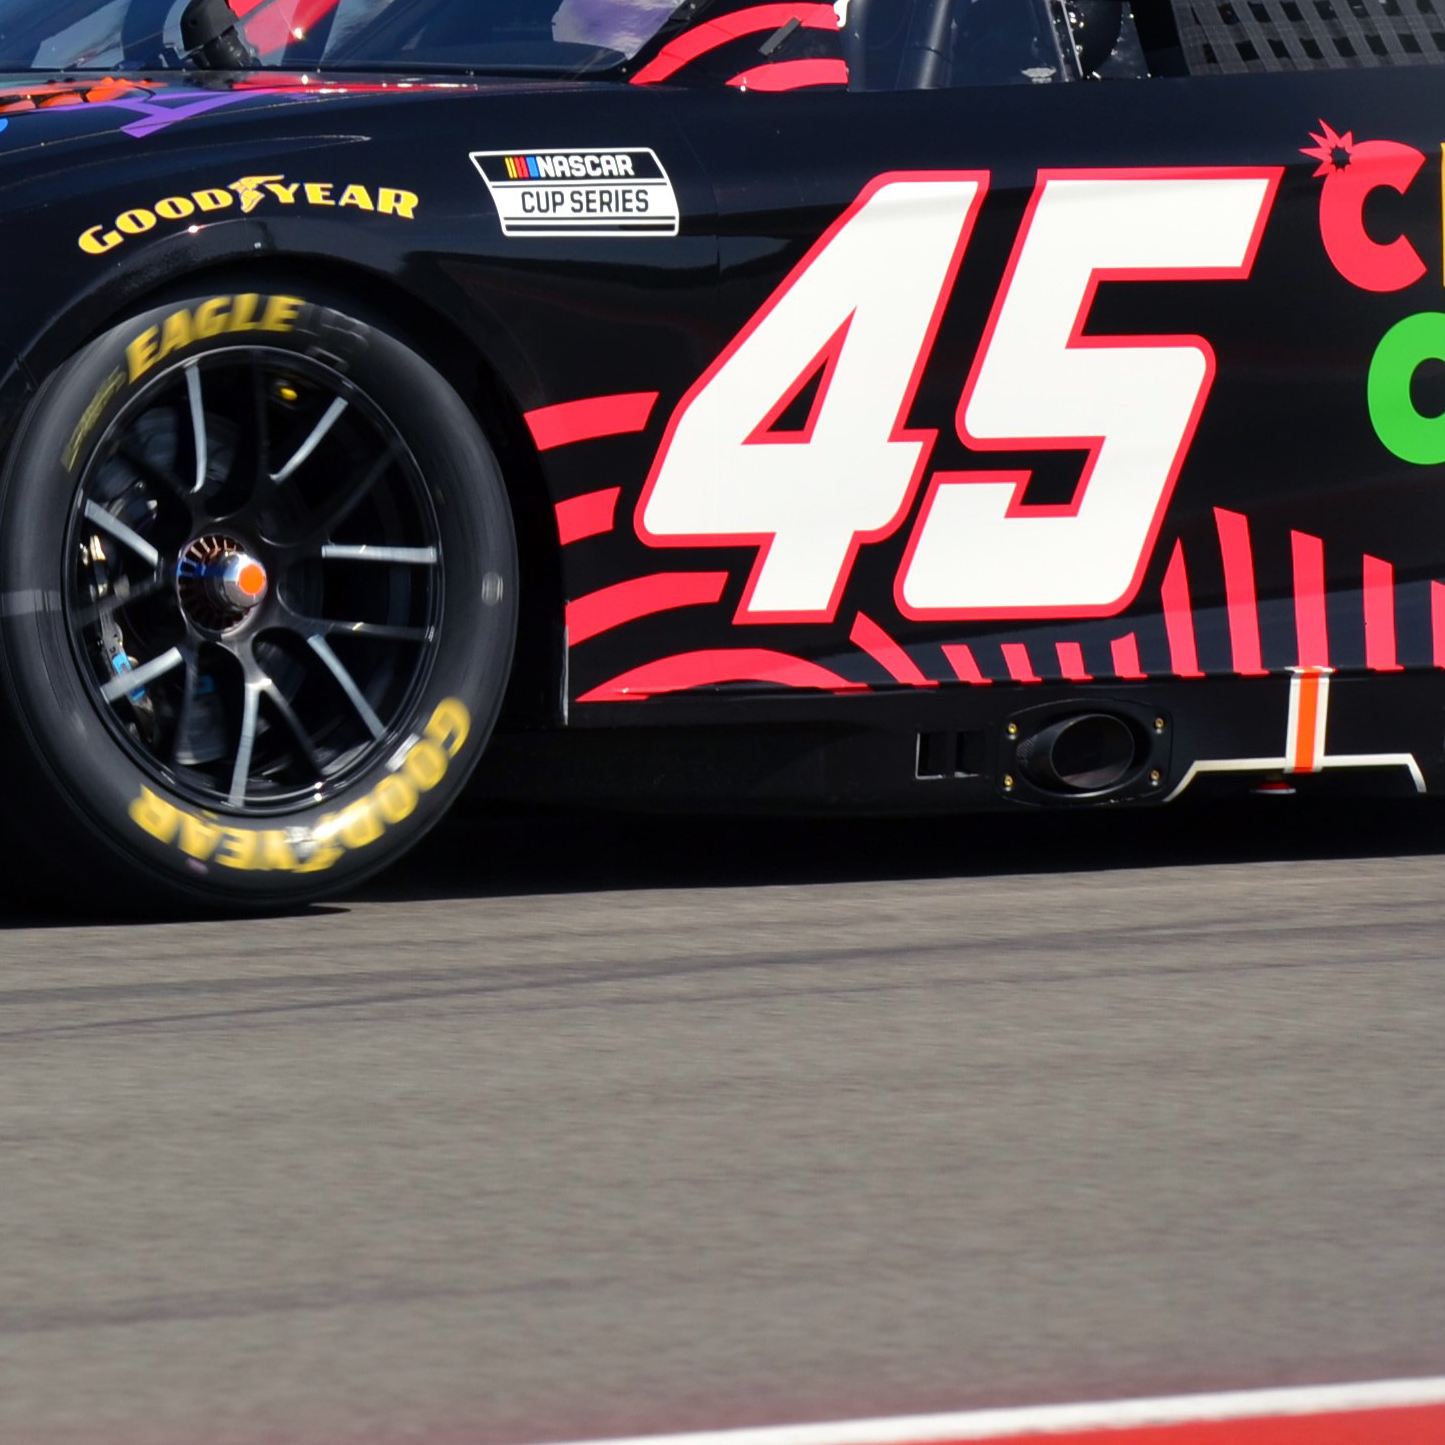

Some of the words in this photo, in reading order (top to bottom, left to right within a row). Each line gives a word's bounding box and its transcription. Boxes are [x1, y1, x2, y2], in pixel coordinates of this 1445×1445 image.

[535, 155, 635, 178] NASCAR
[520, 189, 565, 214] CUP
[570, 188, 650, 213] SERIES
[125, 292, 308, 386] EAGLE
[632, 166, 1286, 624] 45
